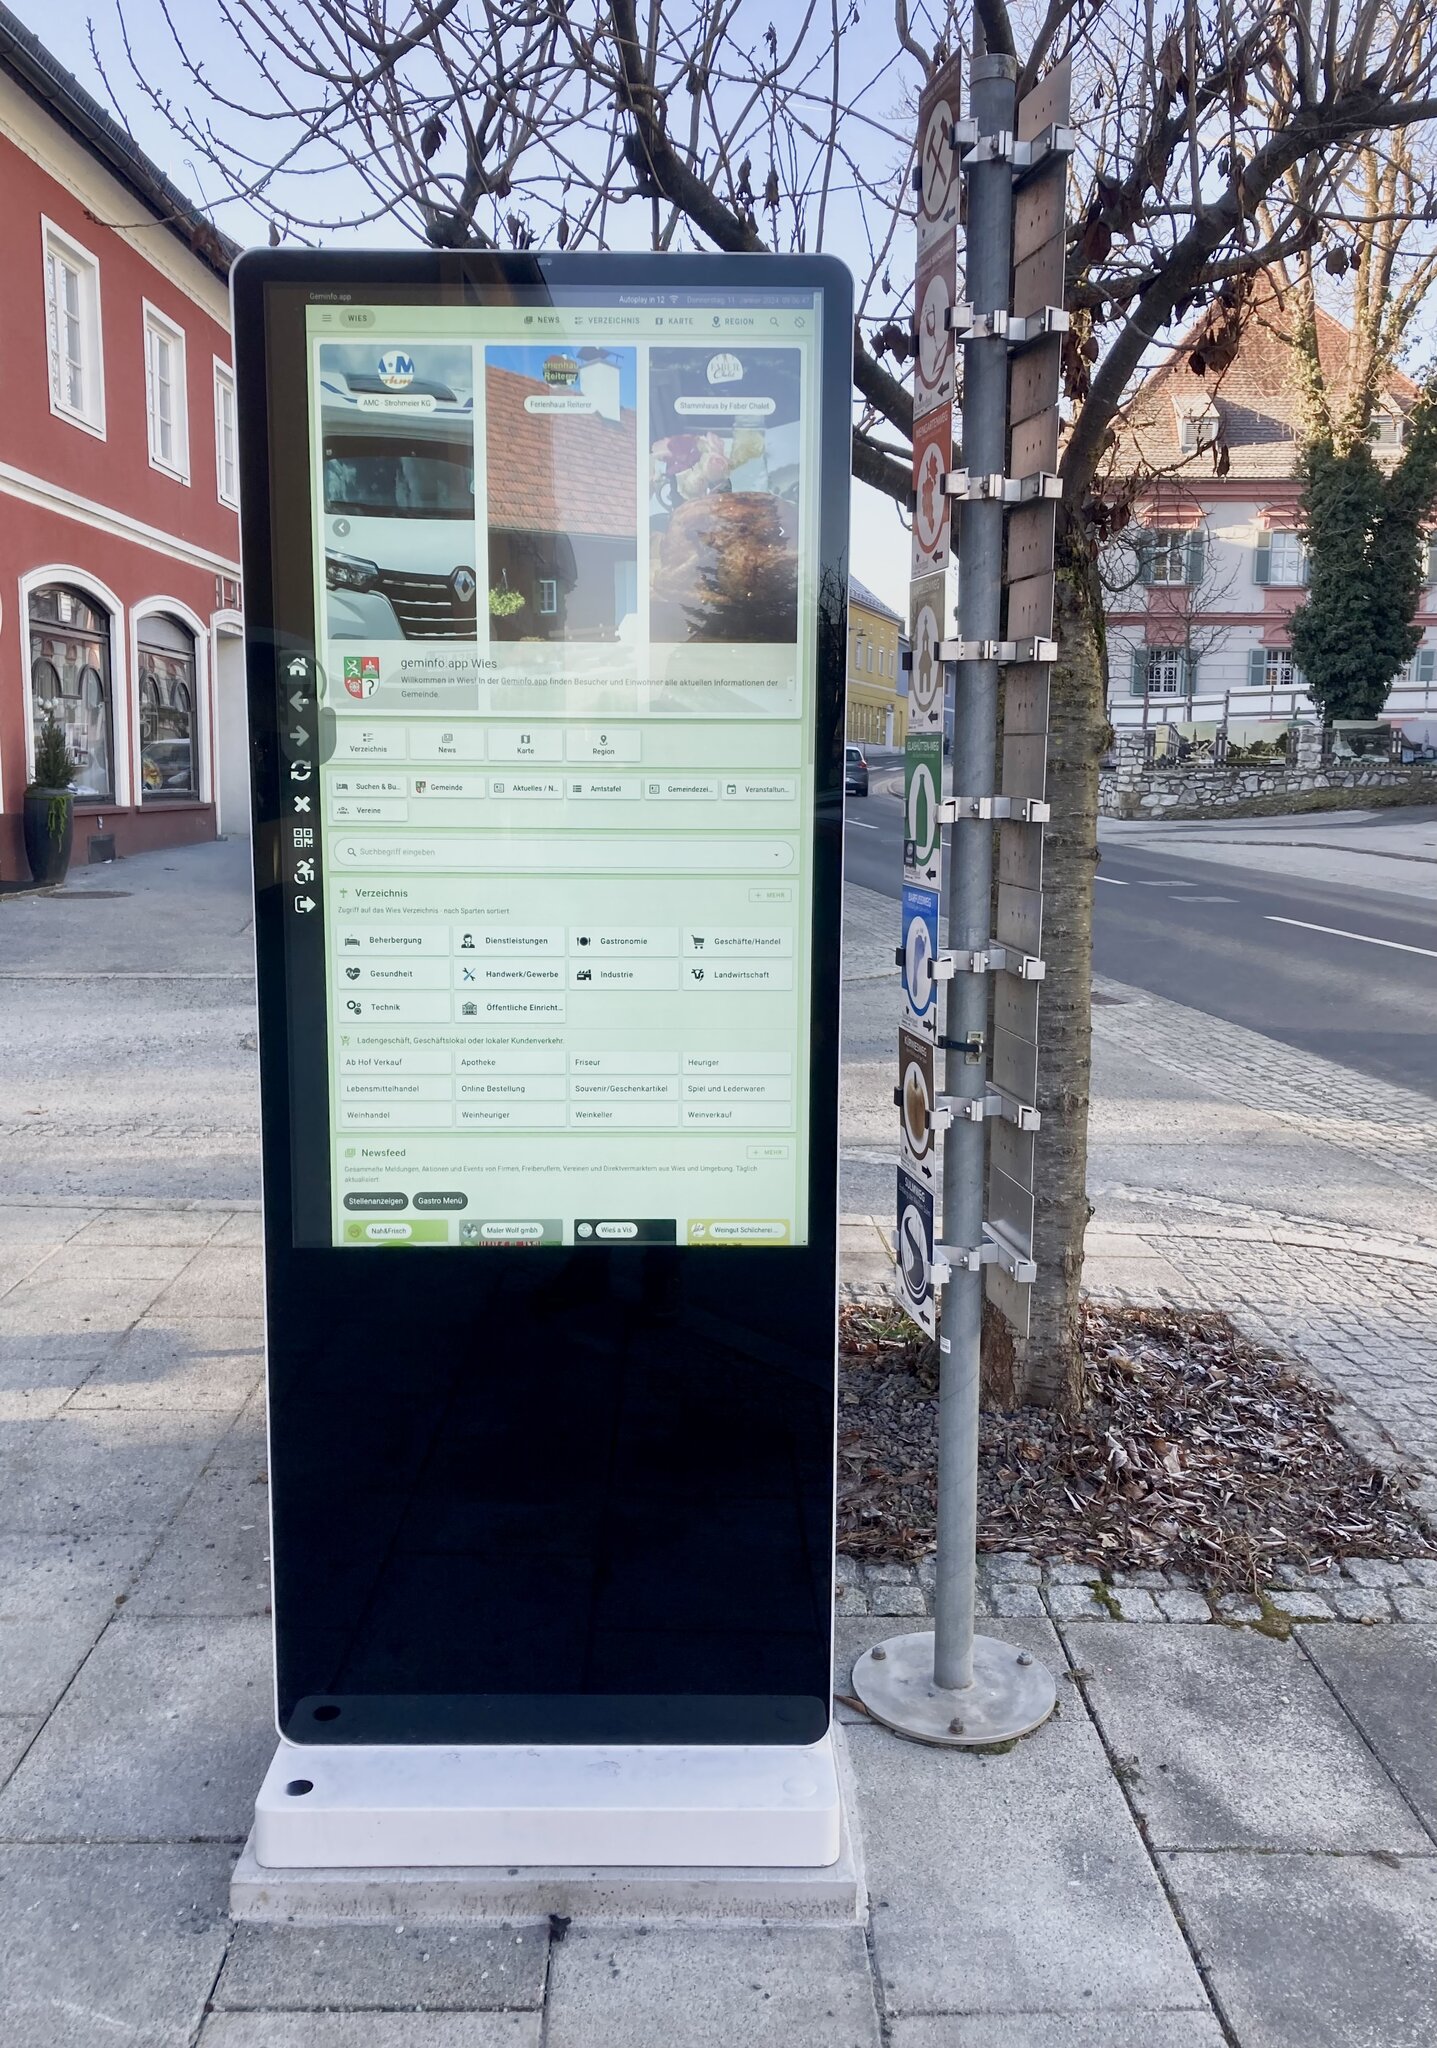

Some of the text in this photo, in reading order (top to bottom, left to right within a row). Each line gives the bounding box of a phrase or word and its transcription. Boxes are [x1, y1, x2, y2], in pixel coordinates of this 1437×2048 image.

[618, 295, 665, 304] Autoplay in 12
[348, 314, 368, 322] WIES
[537, 316, 560, 324] NEWS
[588, 317, 640, 325] VERZEICHNIS
[668, 317, 694, 325] KARTE
[724, 318, 754, 326] REGION
[363, 399, 380, 407] AMC
[384, 399, 420, 407] Strohmeier
[680, 401, 770, 411] Stammhaus by Faber Chalet
[400, 658, 498, 671] geminfo.app Wies
[400, 676, 446, 684] Willkommen
[456, 676, 477, 685] Wies!
[487, 677, 499, 685] der
[500, 677, 548, 687] Geminfo.app
[550, 677, 572, 686] finden
[574, 678, 608, 686] Besucher
[610, 678, 624, 686] und
[625, 679, 664, 687] Einwohner
[664, 679, 678, 687] alle
[679, 679, 712, 687] aktuellen
[714, 679, 765, 687] Informationen
[766, 679, 778, 687] der
[350, 745, 388, 753] Verzeichnis
[438, 746, 456, 754] News
[517, 747, 534, 755] Karte
[592, 748, 615, 756] Region
[356, 783, 380, 791] Suchen
[430, 783, 463, 791] Gemeinde
[512, 784, 542, 792] Aktuelles
[590, 785, 622, 793] Amtstafel
[360, 848, 436, 857] Suchbegriff eingeben
[355, 888, 408, 898] Verzeichnis
[338, 906, 360, 916] Zugriff
[360, 906, 371, 914] auf
[372, 906, 384, 914] das
[402, 907, 439, 915] Verzeichnis
[443, 907, 459, 915] nach
[460, 907, 485, 916] Sparten
[369, 936, 422, 946] Beherbergung
[485, 937, 548, 946] Dienstleistungen
[600, 937, 648, 945] Gastronomie
[714, 937, 781, 946] Geschäfte/Handel
[370, 970, 413, 978] Gesundheit
[486, 970, 559, 979] Handwerk/Gewerbe
[600, 971, 634, 979] Industrie
[714, 971, 770, 979] Landwirtschaft
[371, 1003, 400, 1011] Technik
[486, 1002, 528, 1012] Öffentliche
[356, 1036, 412, 1046] Ladengeschäft,
[413, 1037, 467, 1045] Geschäftslokal
[346, 1058, 402, 1066] Ab Hof Verkauf
[460, 1058, 496, 1068] Apotheke
[575, 1058, 601, 1066] Friseur
[688, 1058, 720, 1068] Heuriger
[346, 1085, 420, 1093] Lebensmittelhandel
[461, 1085, 526, 1094] Online Bestellung
[575, 1084, 668, 1093] Souvenir/Geschenkartikel
[688, 1085, 766, 1094] Spiel und Lederwaren
[347, 1111, 390, 1119] Weinhandel
[462, 1111, 510, 1120] Weinheuriger
[575, 1111, 613, 1119] Weinkeller
[688, 1111, 732, 1119] Weinverkauf
[361, 1148, 406, 1158] Newsfeed
[422, 1165, 449, 1173] Aktionen
[450, 1165, 462, 1173] und
[463, 1165, 483, 1173] Events
[562, 1165, 589, 1173] Vereinen
[590, 1165, 602, 1173] und
[671, 1165, 686, 1173] Wies
[687, 1165, 699, 1173] und
[736, 1165, 758, 1173] Täglich
[348, 1197, 404, 1206] Stellenanzeigen
[418, 1197, 463, 1205] Gastro Menü
[371, 1227, 407, 1235] Nah&Frisch
[520, 1227, 538, 1235] gmbh
[714, 1226, 738, 1235] Weingut
